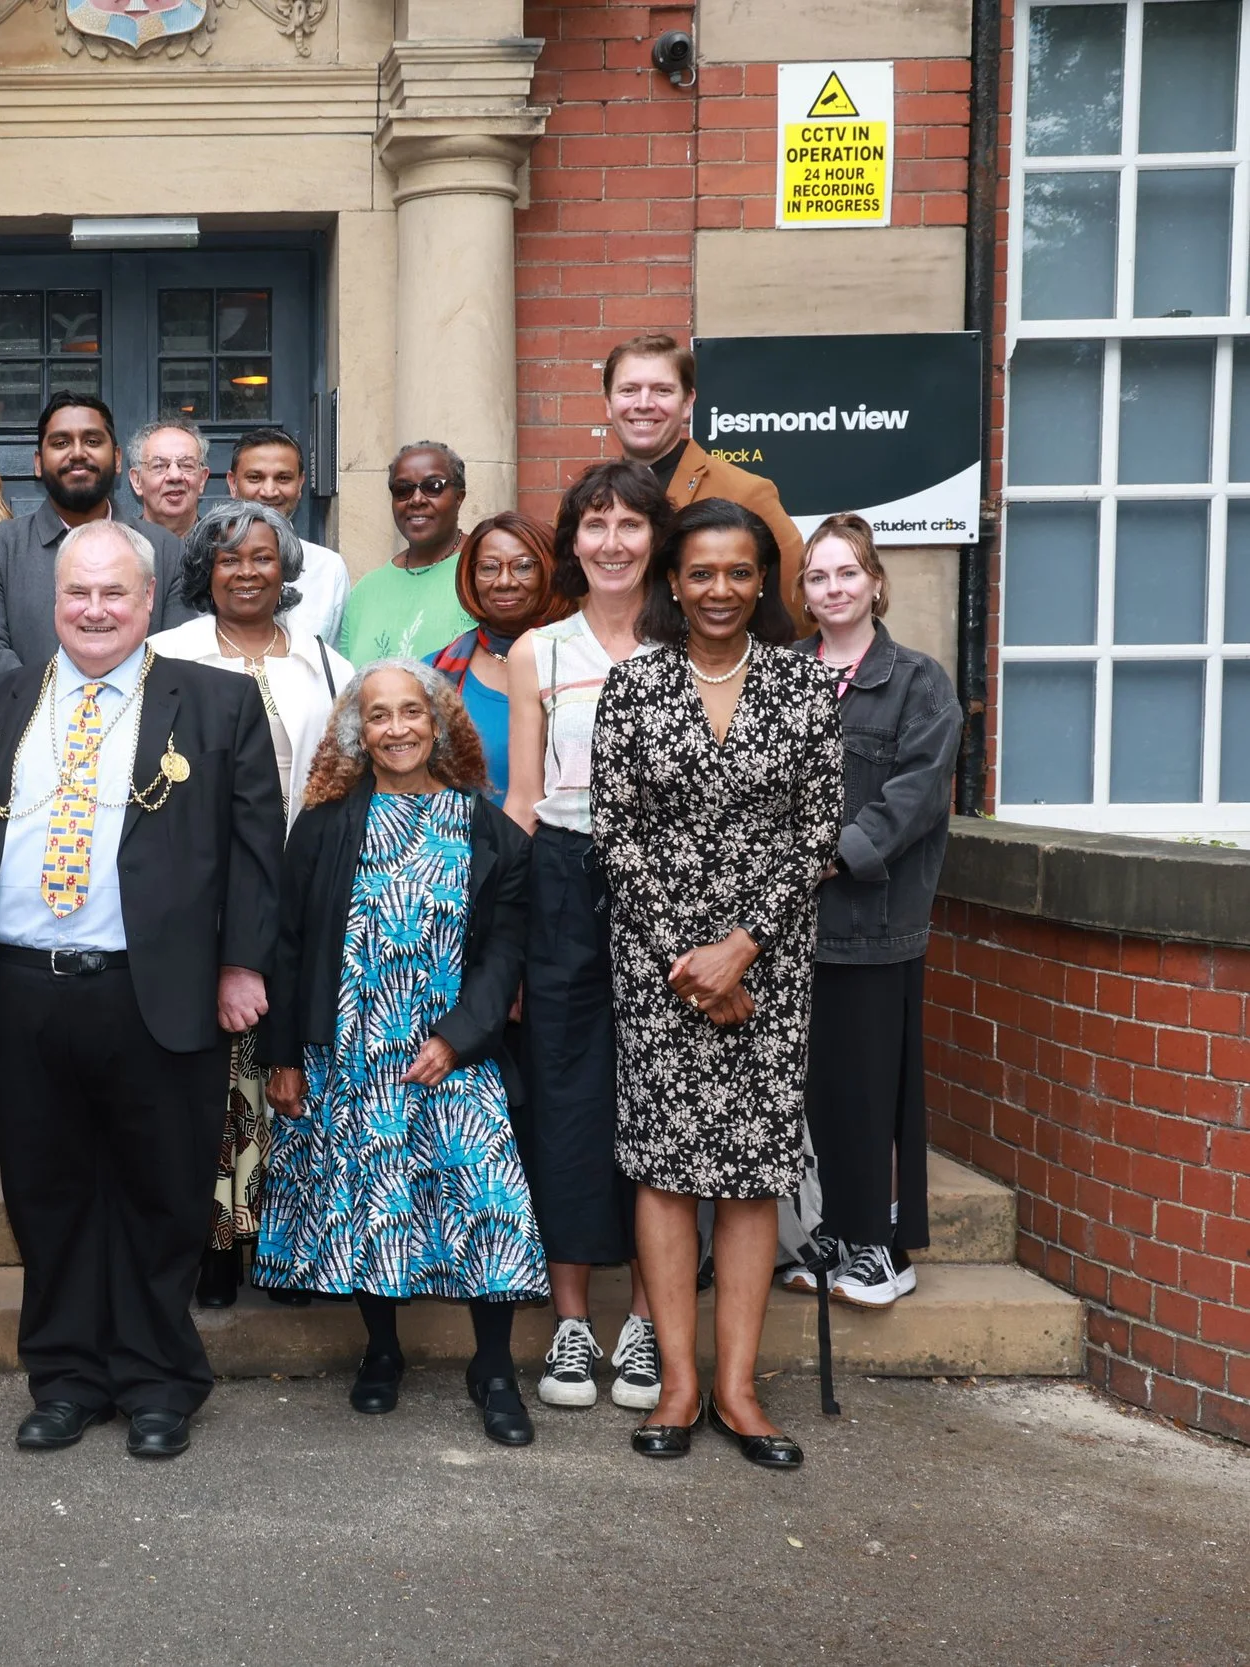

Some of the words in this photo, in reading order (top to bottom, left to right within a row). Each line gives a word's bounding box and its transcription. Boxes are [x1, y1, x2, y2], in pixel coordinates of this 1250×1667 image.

[801, 127, 847, 143] CCTV
[852, 126, 870, 141] IN
[786, 145, 884, 163] OPERATION
[804, 168, 821, 181] 24
[825, 167, 865, 181] HOUR
[793, 182, 875, 197] RECORDING
[787, 200, 802, 213] IN
[806, 198, 880, 213] PROGRESS
[708, 406, 836, 441] jesmond
[840, 403, 909, 431] view
[752, 449, 763, 462] A
[873, 518, 927, 533] student
[930, 517, 966, 531] cribs
